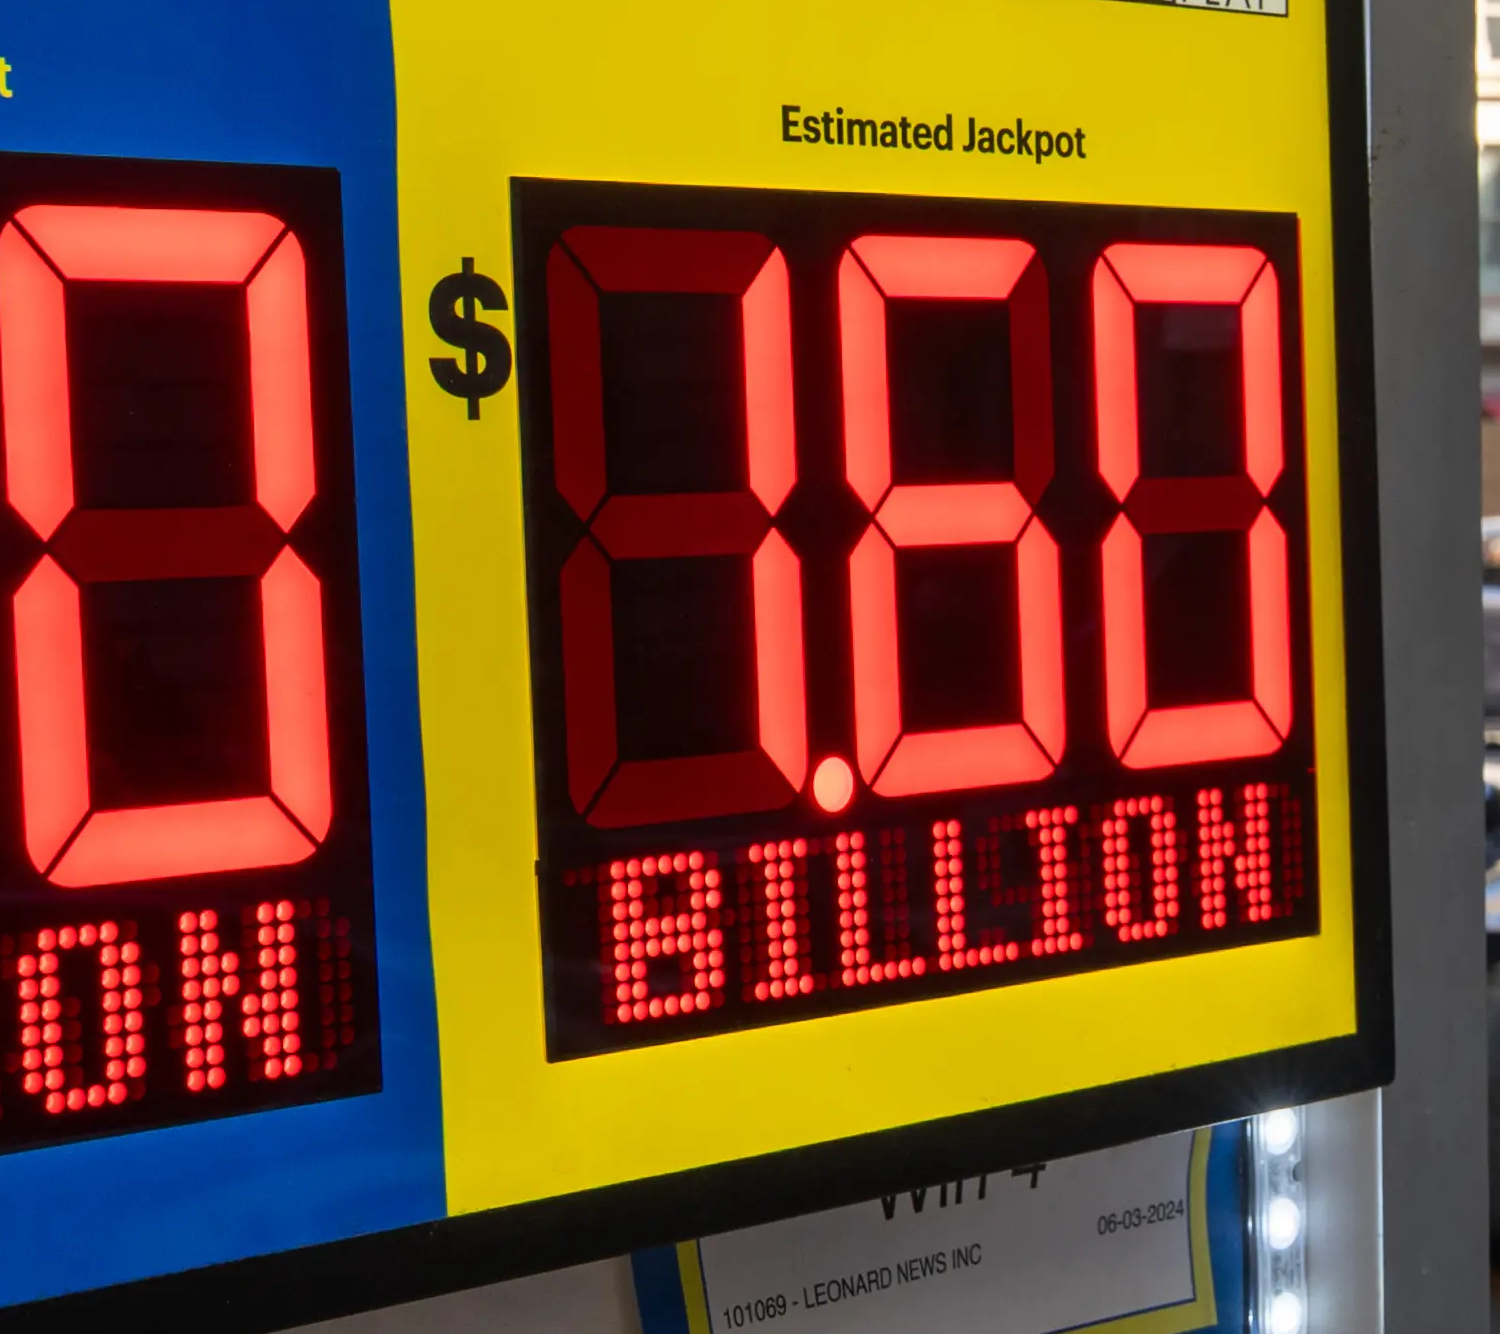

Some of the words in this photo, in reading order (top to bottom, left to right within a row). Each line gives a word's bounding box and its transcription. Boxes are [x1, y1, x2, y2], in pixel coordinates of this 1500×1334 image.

[781, 104, 954, 152] Estimated
[962, 117, 1087, 165] Jackpot
[428, 257, 513, 421] $
[741, 234, 1294, 815] 1.60
[608, 782, 1273, 1024] BILLION
[1096, 1198, 1186, 1236] 06-03-2024
[722, 1294, 788, 1329] 101069
[802, 1266, 892, 1311] LEONARD
[896, 1251, 948, 1285] NEWS
[951, 1243, 983, 1272] INC
